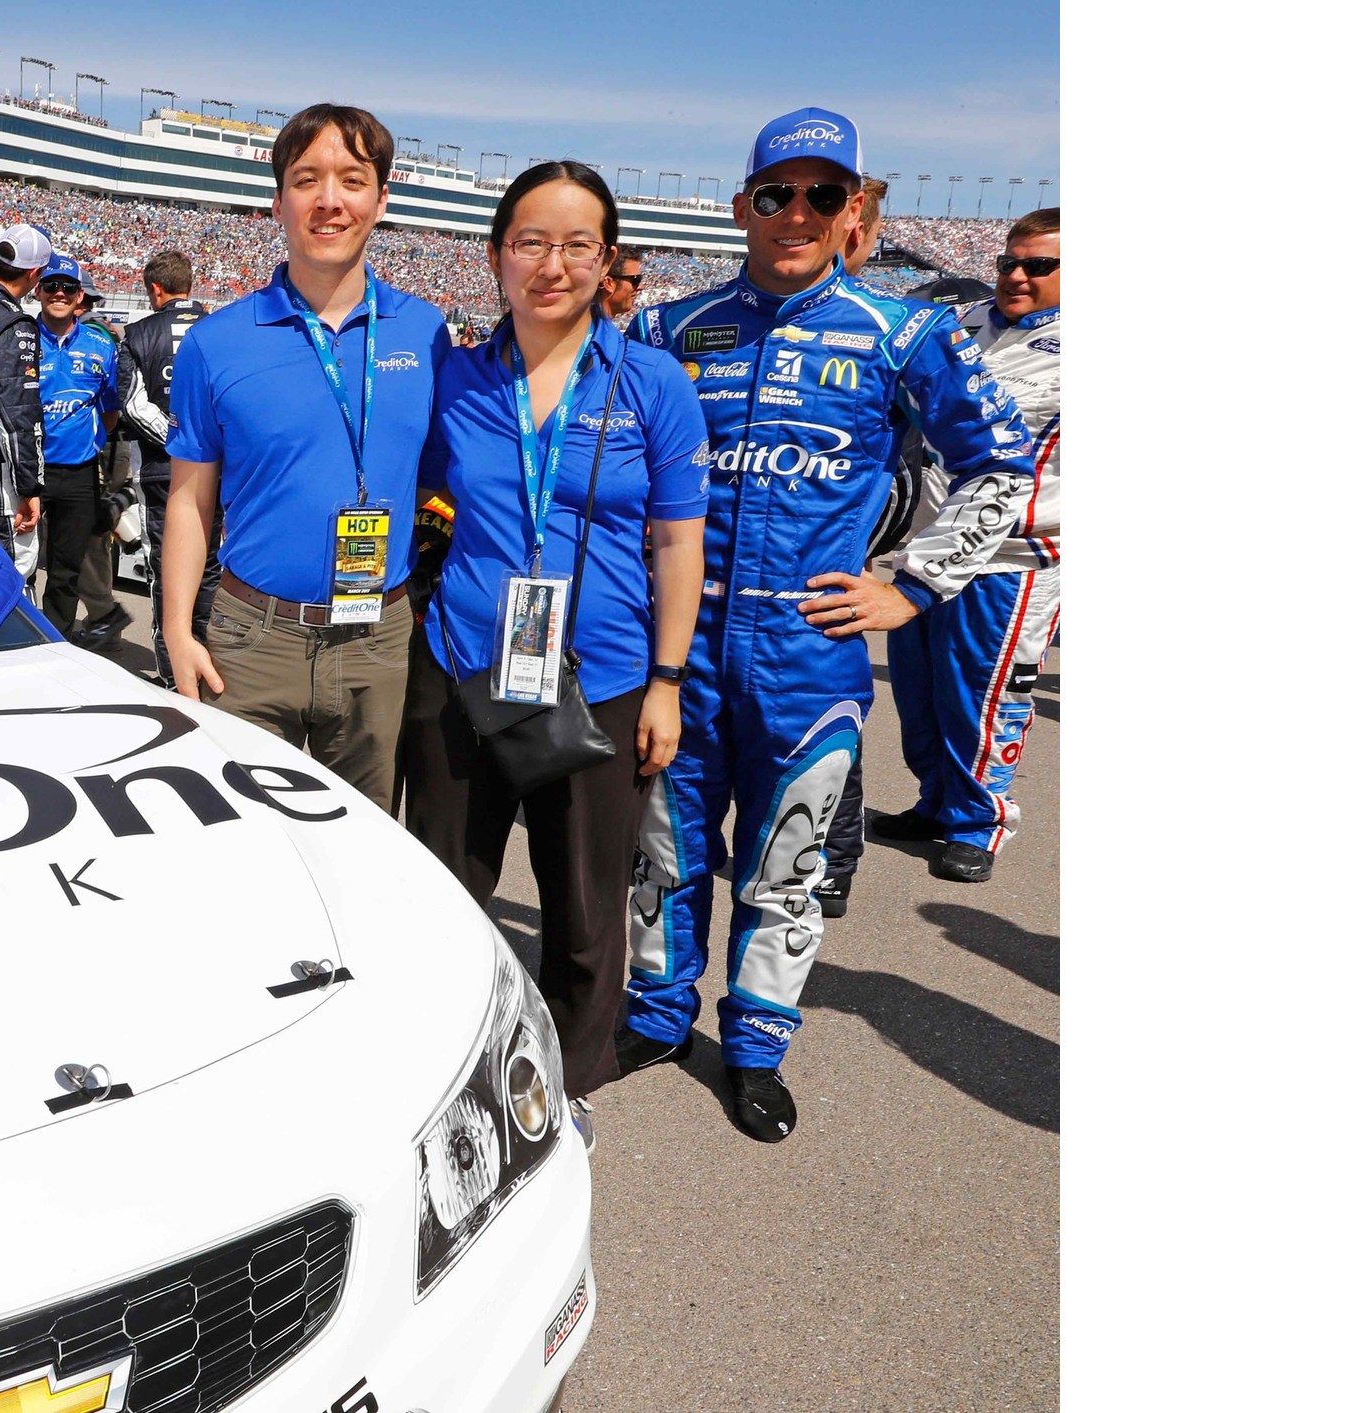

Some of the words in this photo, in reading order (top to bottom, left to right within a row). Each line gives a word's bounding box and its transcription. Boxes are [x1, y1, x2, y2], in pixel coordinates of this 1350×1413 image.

[769, 127, 842, 149] CreditOne
[782, 141, 826, 150] BANK
[1034, 312, 1060, 327] Mob
[894, 308, 932, 350] sparco
[833, 332, 872, 344] GANASSI
[767, 372, 799, 383] Cessna
[997, 375, 1039, 388] GOODYEAR
[699, 390, 747, 401] OODYEAR
[768, 386, 797, 397] GEAR
[759, 395, 803, 406] WRENCH
[579, 413, 635, 428] CredOne
[708, 441, 852, 481] editOne
[728, 474, 800, 492] ANK
[347, 518, 379, 533] HOT
[923, 476, 1021, 578] CreditOne
[332, 602, 380, 614] CreditOne
[986, 702, 1033, 794] Mobil
[742, 1014, 791, 1041] CreditOn
[546, 1291, 588, 1360] RACING
